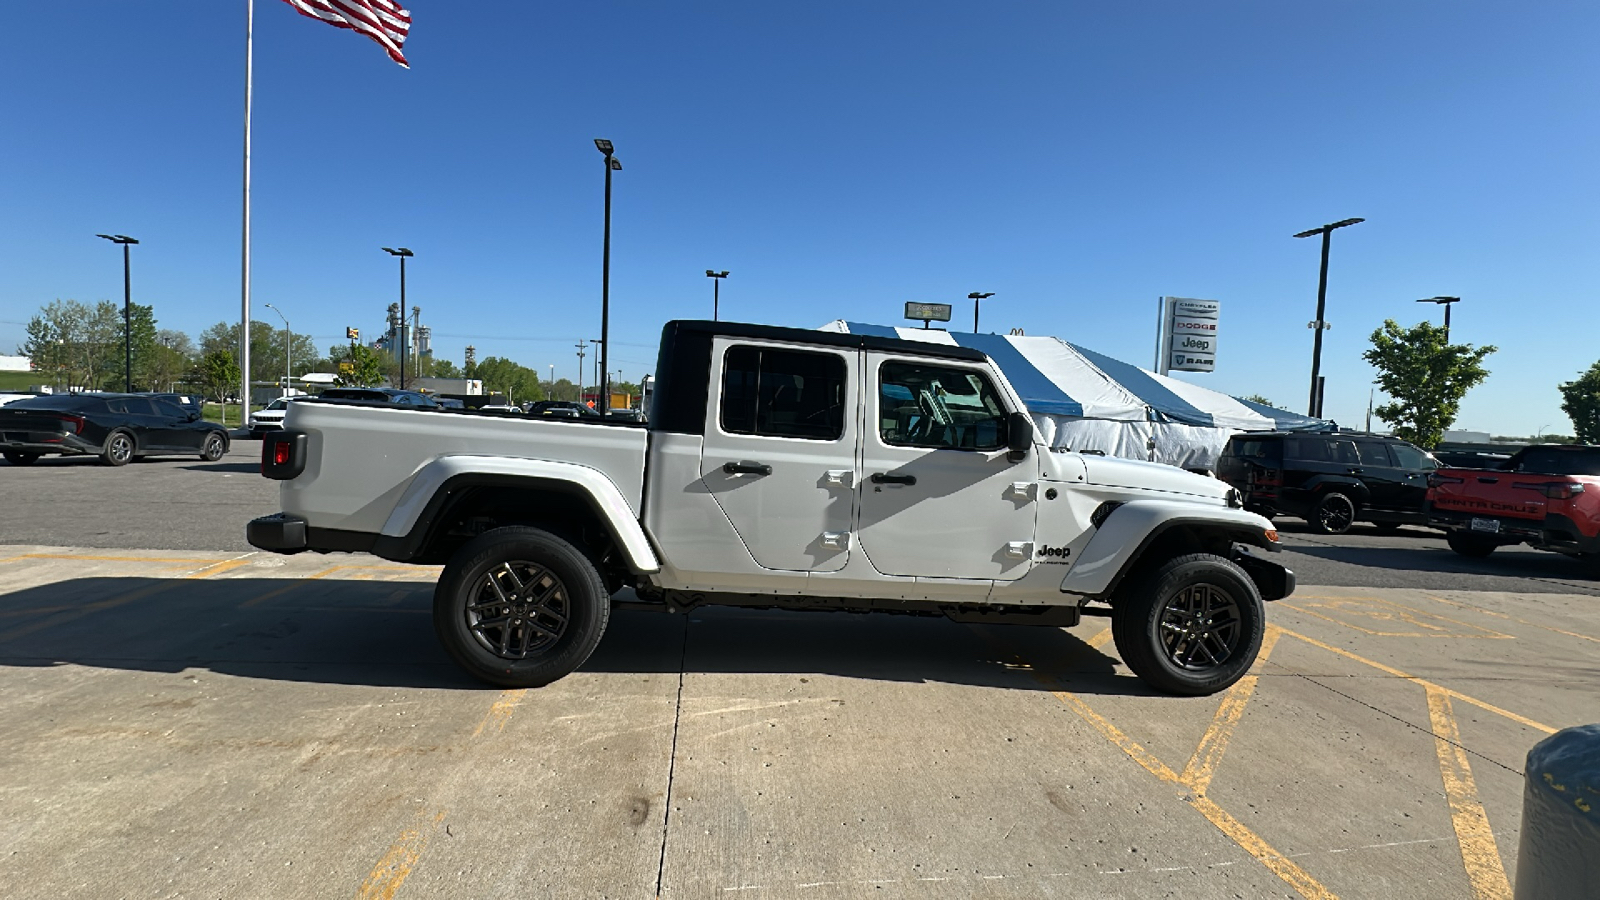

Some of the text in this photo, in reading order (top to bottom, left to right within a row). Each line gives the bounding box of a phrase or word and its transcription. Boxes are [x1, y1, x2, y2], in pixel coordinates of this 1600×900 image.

[1182, 337, 1209, 350] Jeep
[1438, 499, 1538, 513] SANTA CRUZ
[1038, 545, 1070, 558] Jeep
